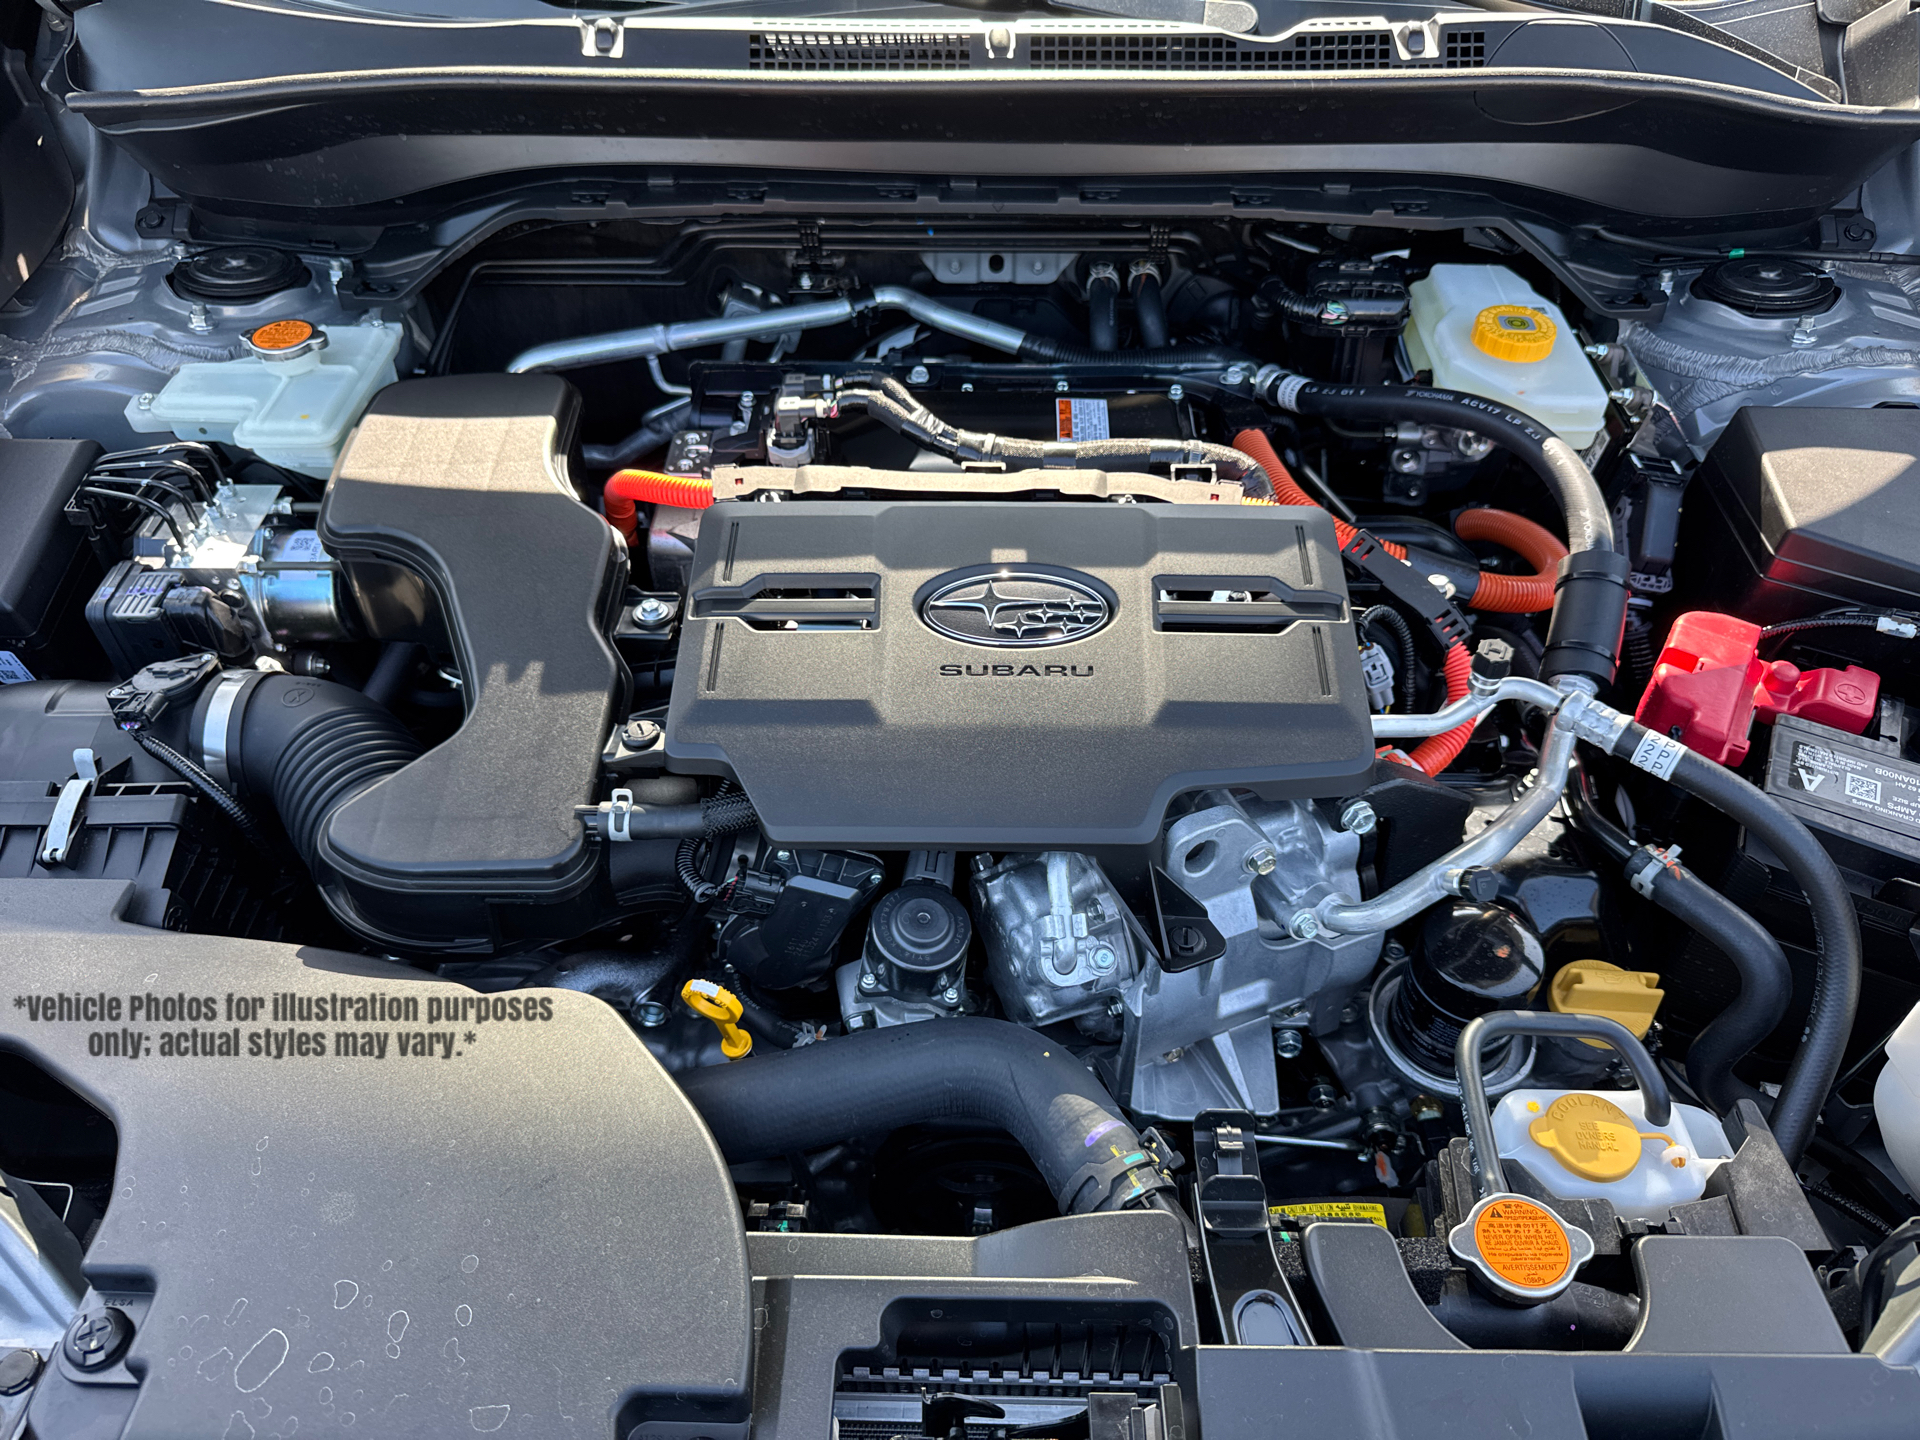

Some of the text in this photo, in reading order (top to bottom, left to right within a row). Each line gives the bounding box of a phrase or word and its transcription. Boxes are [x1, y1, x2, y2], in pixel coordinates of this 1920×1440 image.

[1460, 397, 1502, 415] ACV17
[939, 664, 1094, 677] SUBARU
[1887, 802, 1917, 816] AMPS
[1551, 1098, 1626, 1122] COOLANT
[1578, 1121, 1600, 1131] SEE
[1575, 1131, 1617, 1142] OWNERS
[1577, 1141, 1620, 1152] MANUAL
[1287, 1205, 1307, 1213] CAUTION
[1308, 1204, 1334, 1212] ATTENTION
